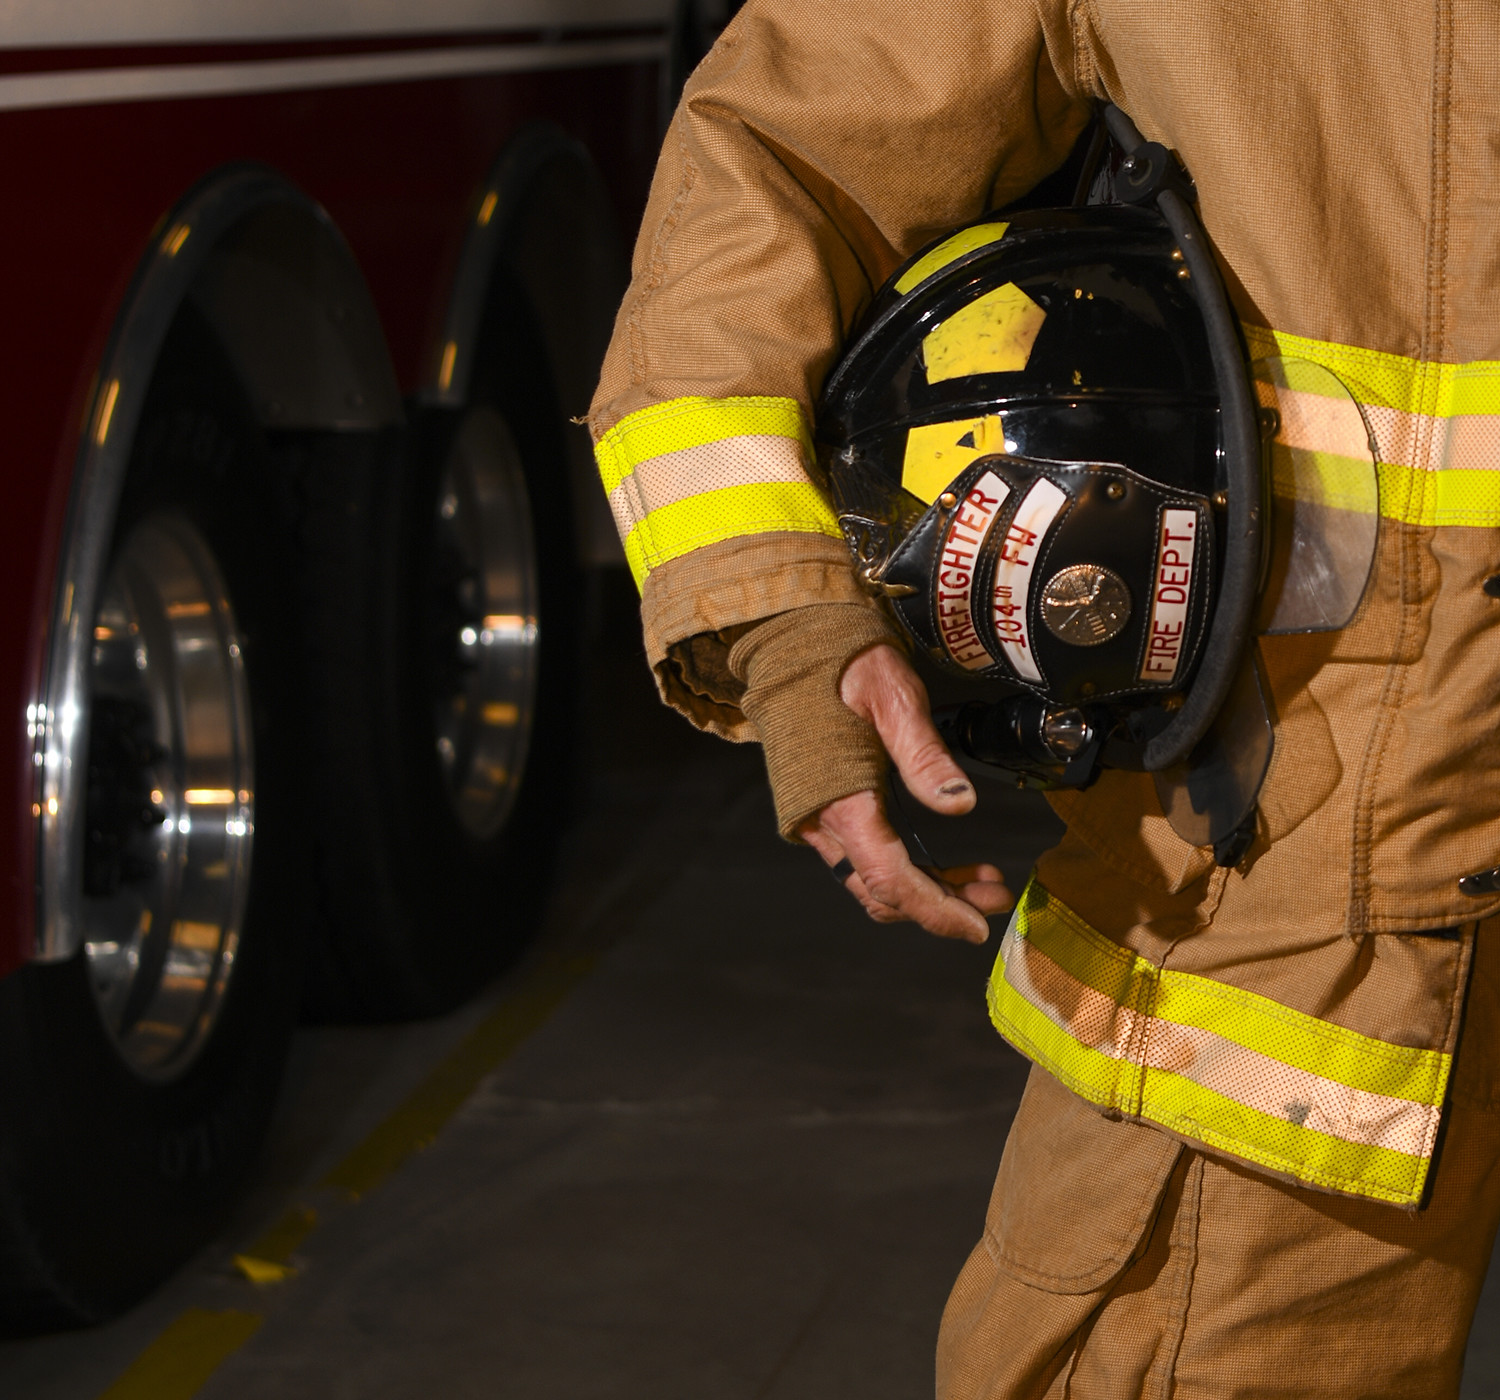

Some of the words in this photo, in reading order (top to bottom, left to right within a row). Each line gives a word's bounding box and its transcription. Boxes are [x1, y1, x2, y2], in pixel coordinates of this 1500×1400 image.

[939, 488, 998, 664] FIREFIGHTER
[1001, 524, 1038, 566] FW
[1157, 522, 1194, 604] DEPT.
[1145, 621, 1183, 673] FIRE
